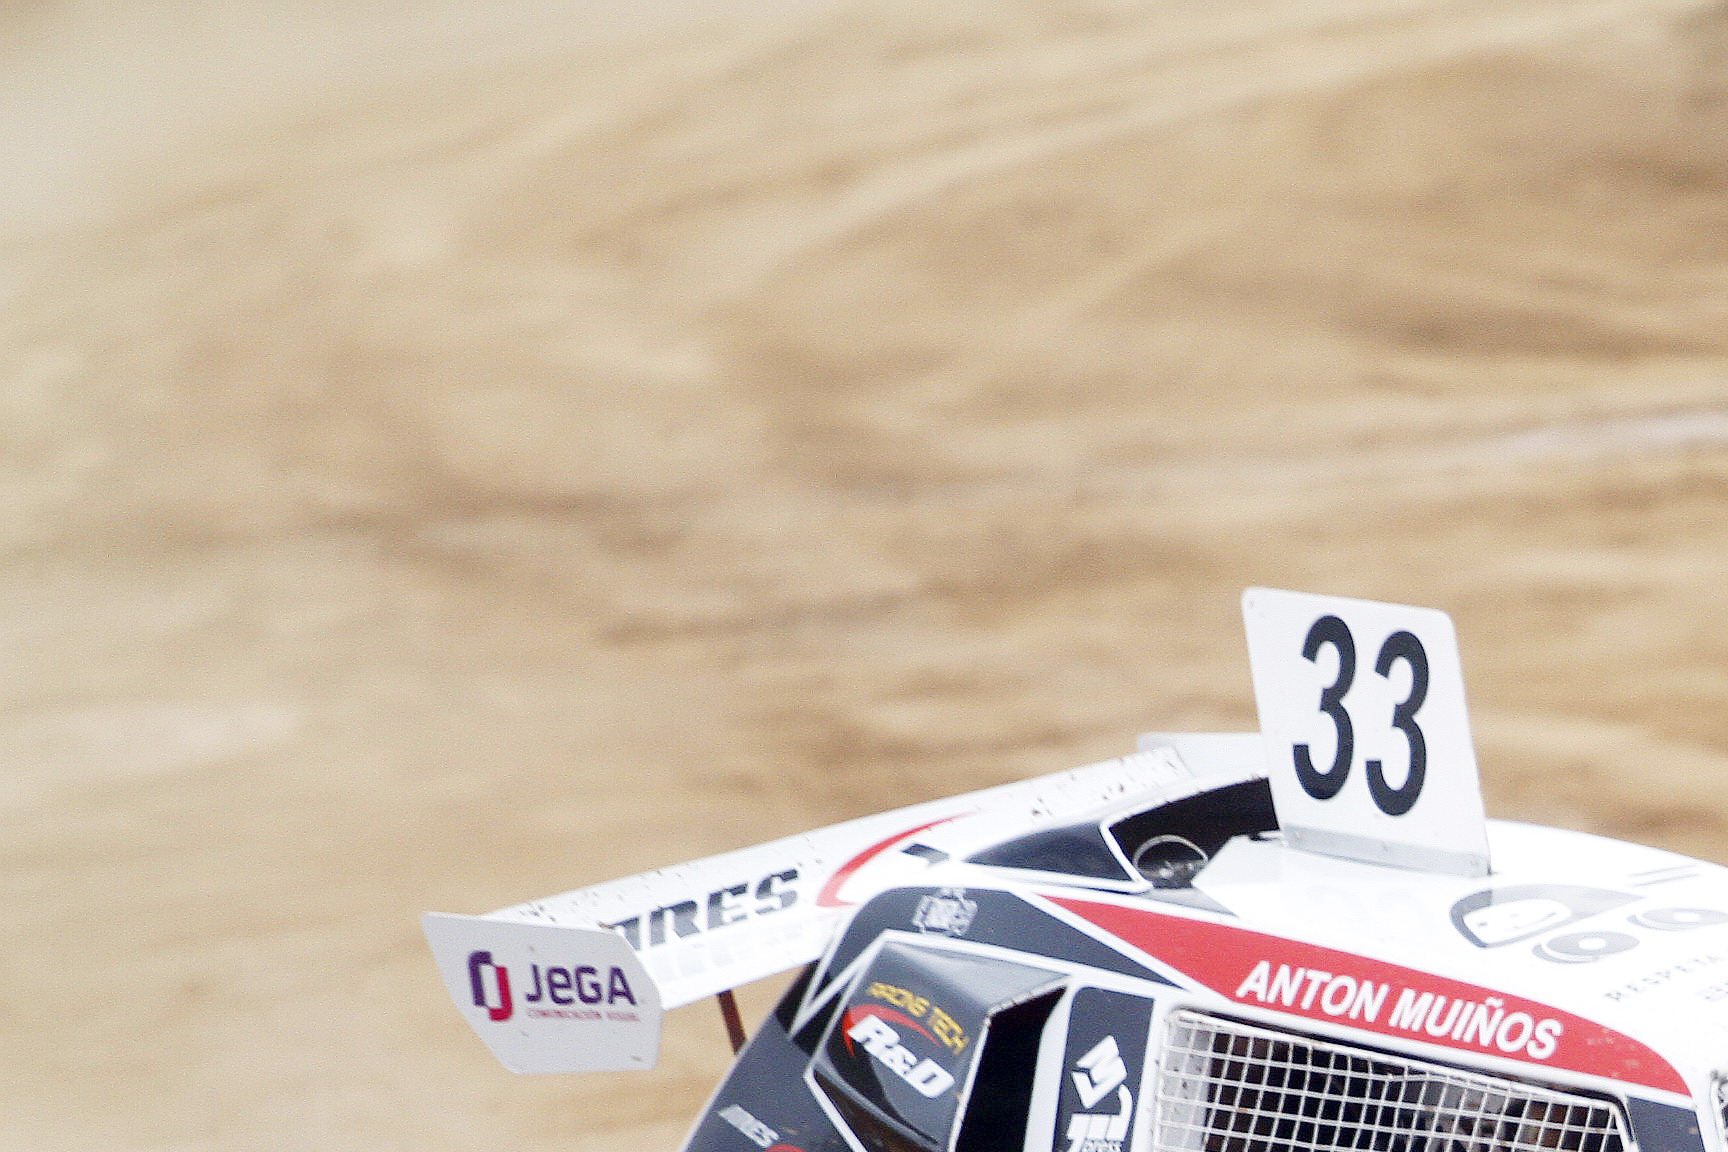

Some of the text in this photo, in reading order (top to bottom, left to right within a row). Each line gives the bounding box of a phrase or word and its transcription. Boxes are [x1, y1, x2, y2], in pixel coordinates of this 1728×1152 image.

[1293, 615, 1429, 816] 33
[848, 1014, 956, 1098] R&D
[1235, 960, 1564, 1060] ANTON MUIÑOS
